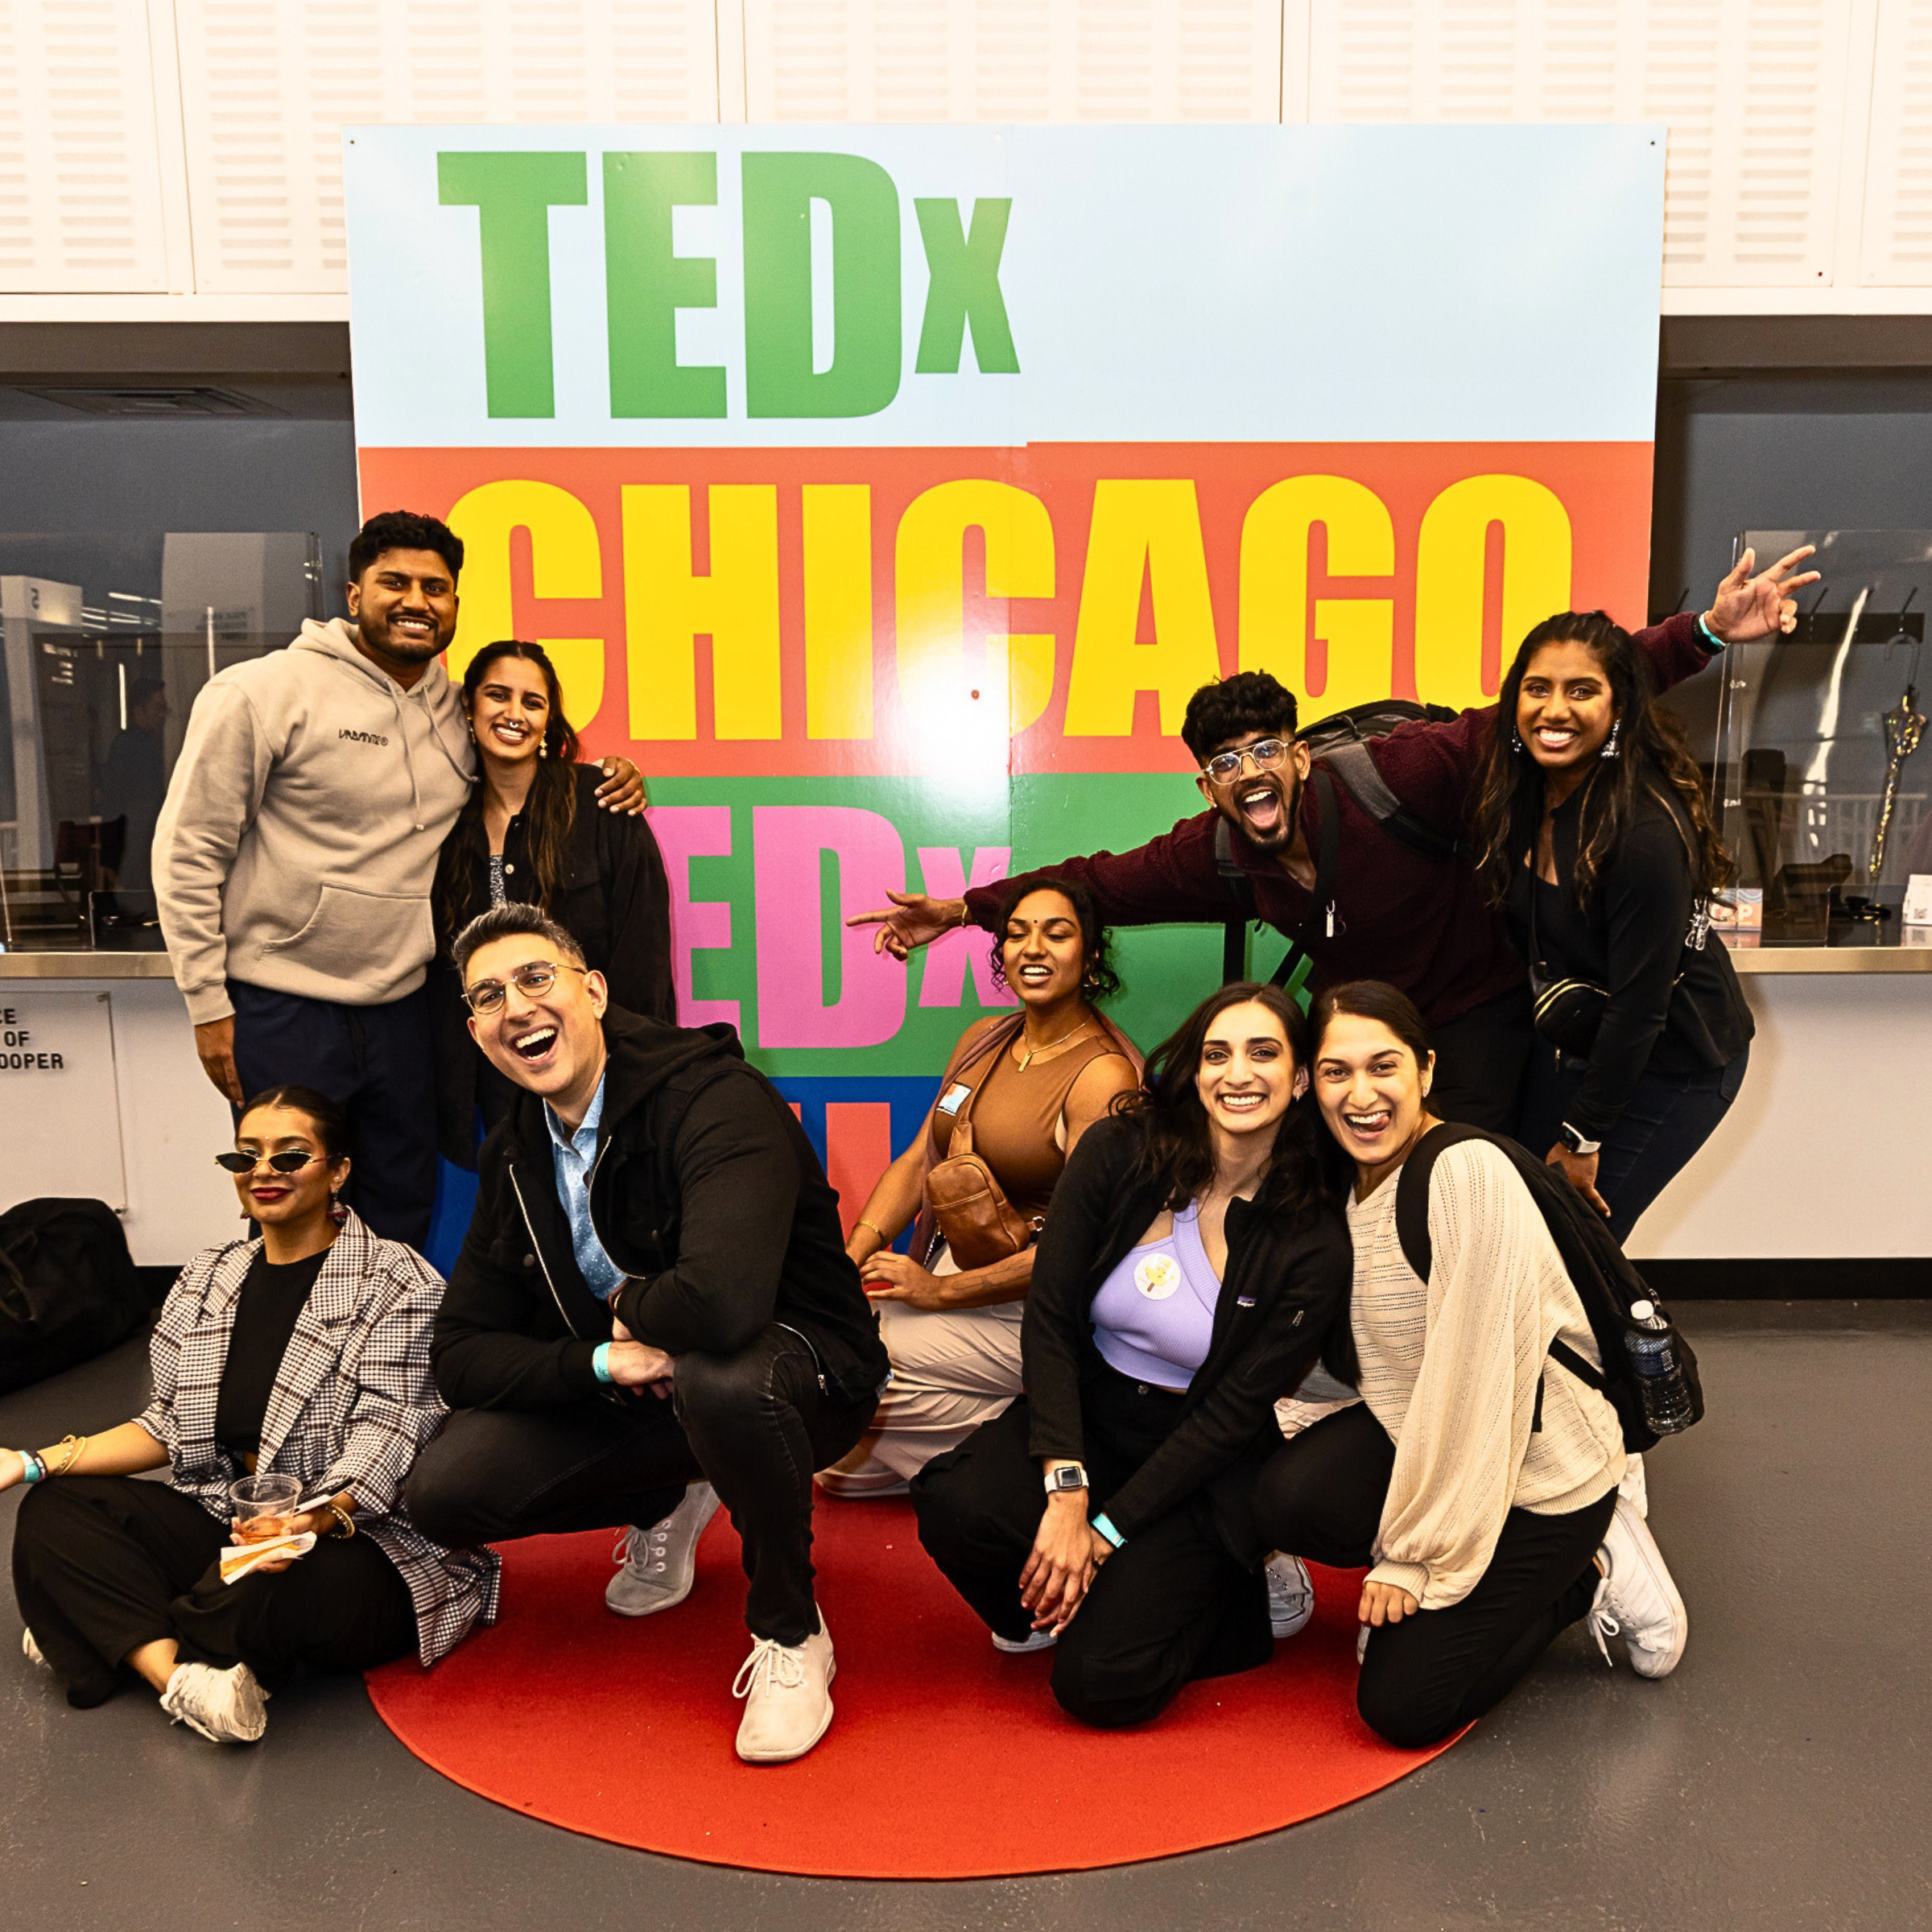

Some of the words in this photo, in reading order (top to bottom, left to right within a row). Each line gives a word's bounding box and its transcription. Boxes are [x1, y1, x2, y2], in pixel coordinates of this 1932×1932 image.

[437, 151, 1020, 418] TEDx
[445, 473, 1572, 741] CHICAGO
[0, 1009, 16, 1024] E
[4, 1031, 29, 1046] OF
[646, 806, 1020, 1049] EDx
